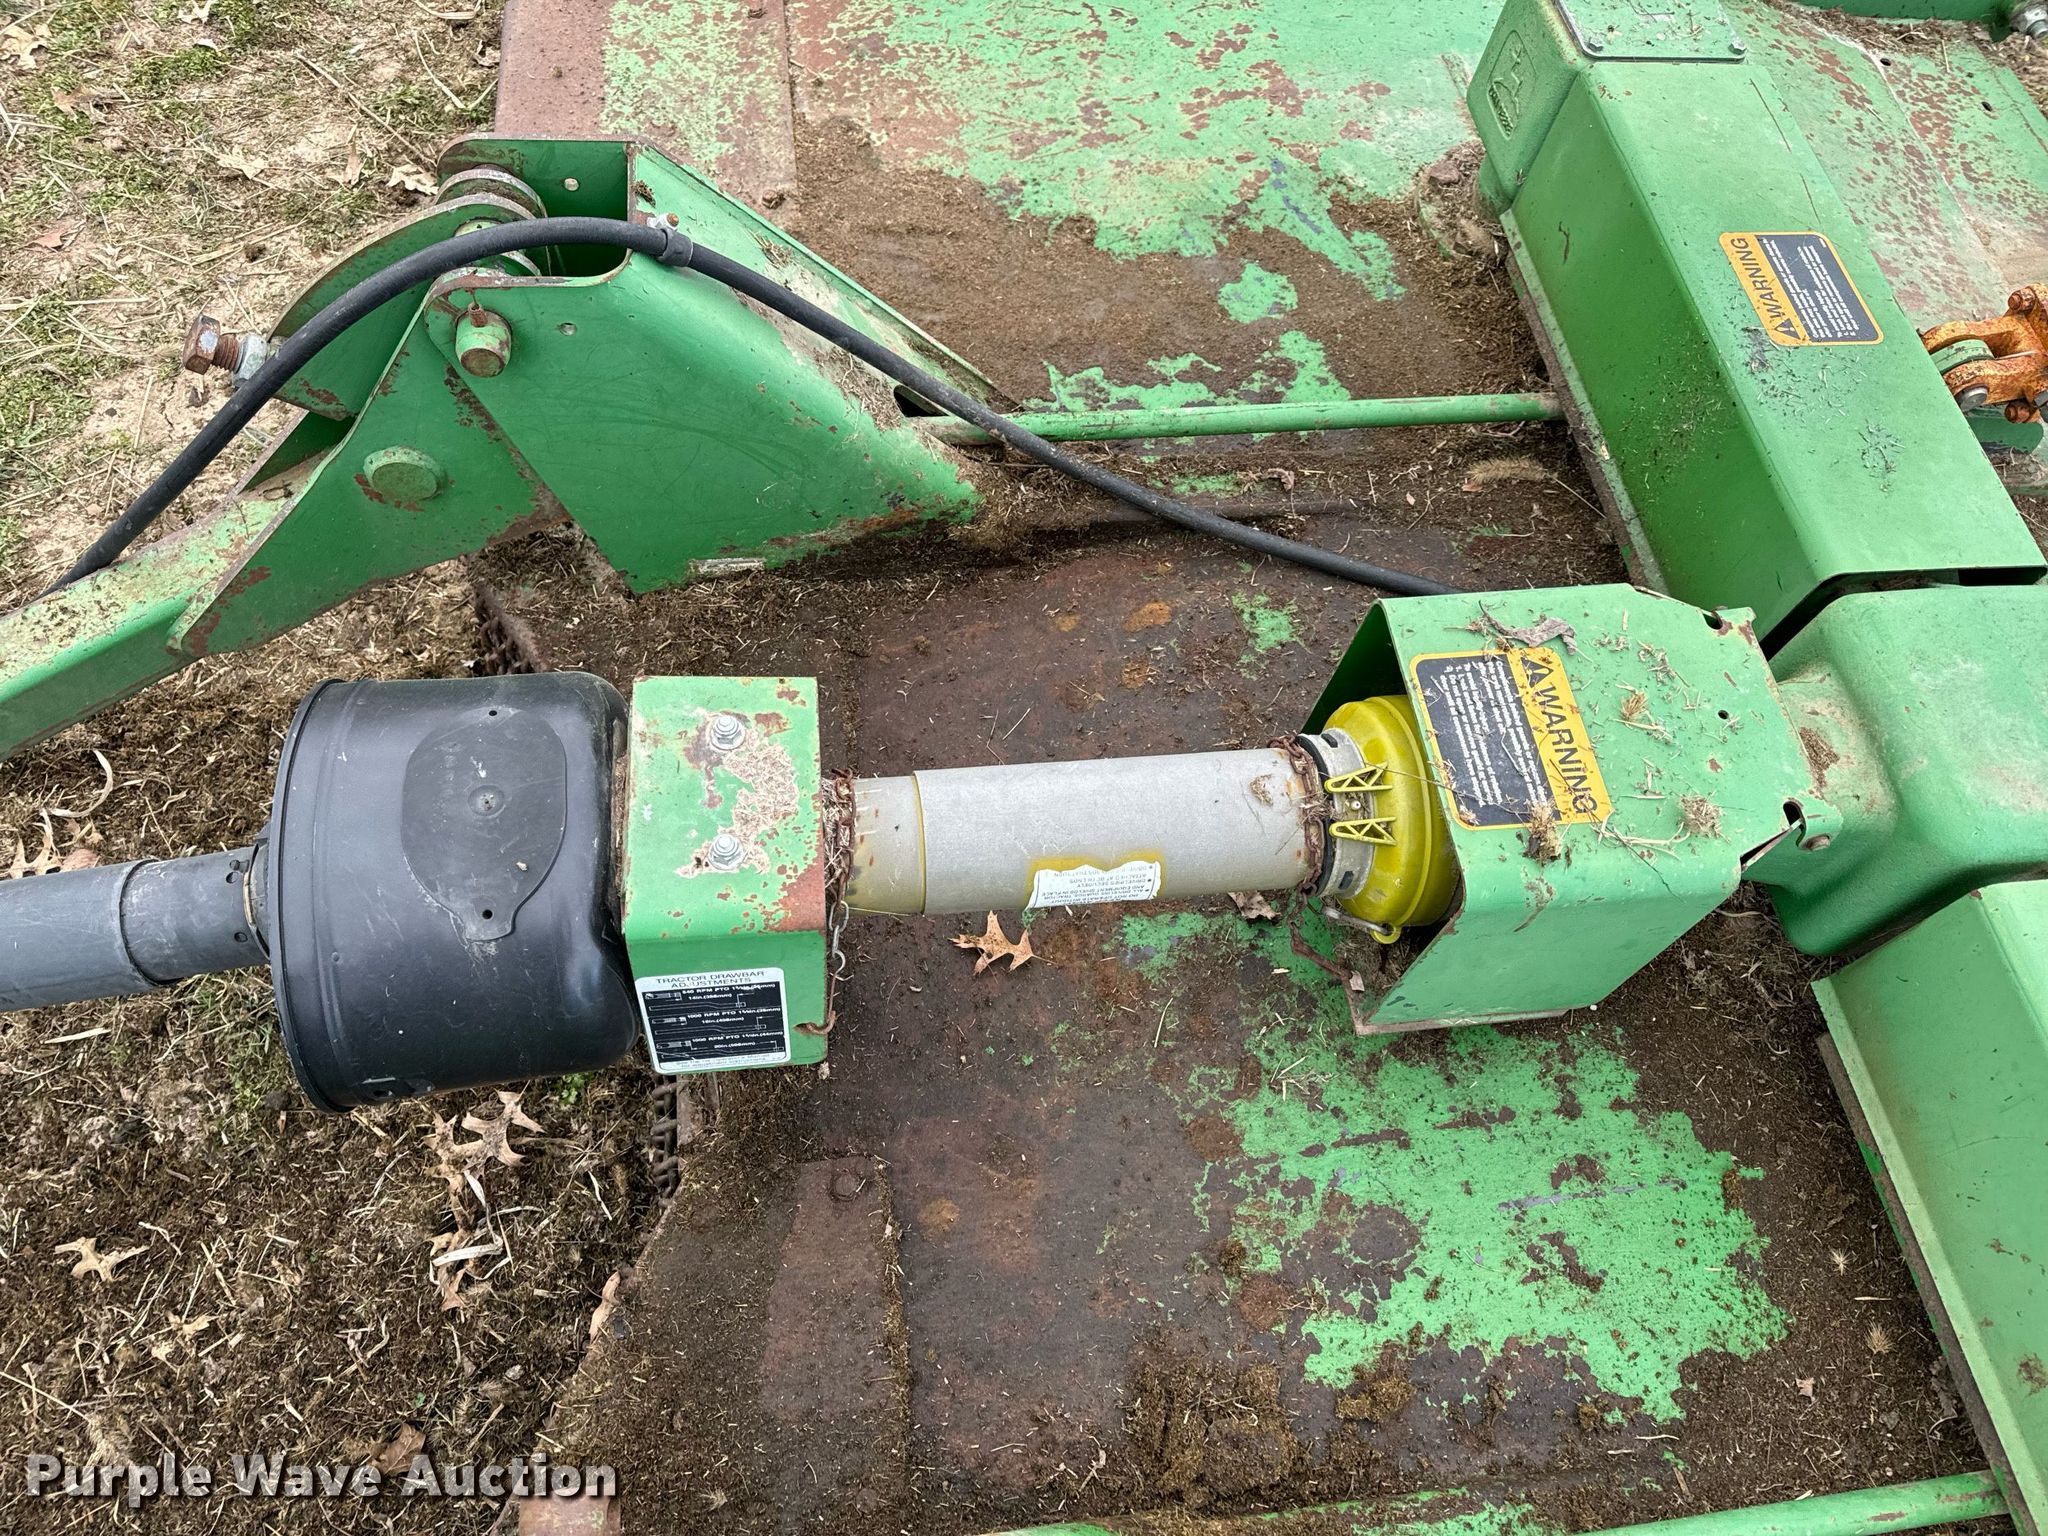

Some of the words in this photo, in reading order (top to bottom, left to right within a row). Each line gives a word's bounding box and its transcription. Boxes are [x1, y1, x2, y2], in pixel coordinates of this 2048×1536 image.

[1728, 237, 1787, 318] WARNING
[1534, 686, 1599, 814] WARNING
[655, 974, 707, 984] TRACTOR
[709, 970, 765, 980] DRAWBAR
